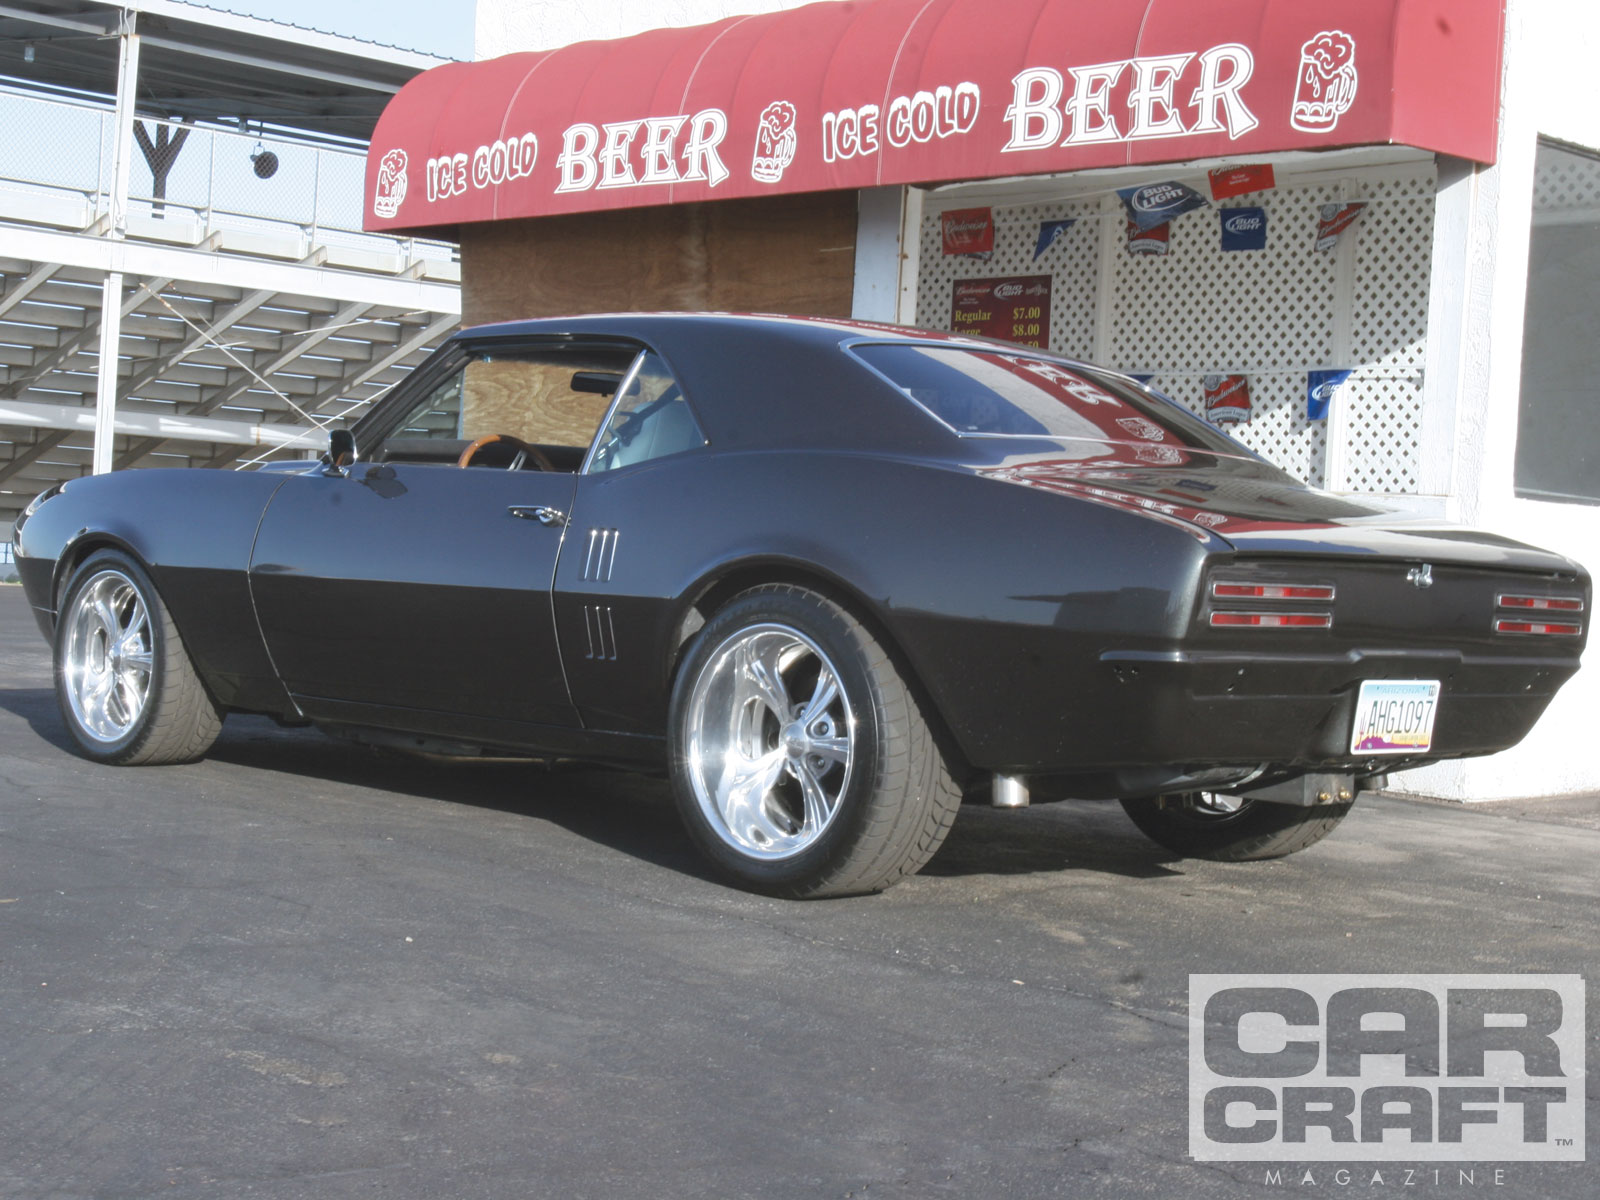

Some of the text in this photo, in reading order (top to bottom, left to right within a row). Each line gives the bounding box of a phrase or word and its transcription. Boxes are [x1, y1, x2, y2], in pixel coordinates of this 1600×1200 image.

[822, 43, 1259, 163] ICE COLD BEER
[426, 108, 730, 202] ICE COLD BEER
[1142, 185, 1173, 198] BUD
[1143, 188, 1184, 209] LIGHT
[1231, 223, 1262, 231] LIGHT
[1235, 217, 1260, 225] BUD
[954, 306, 1041, 324] Regular $7.00
[1012, 323, 1040, 337] $8.00
[1208, 379, 1246, 407] Budweiser
[1367, 700, 1434, 735] AHG1097
